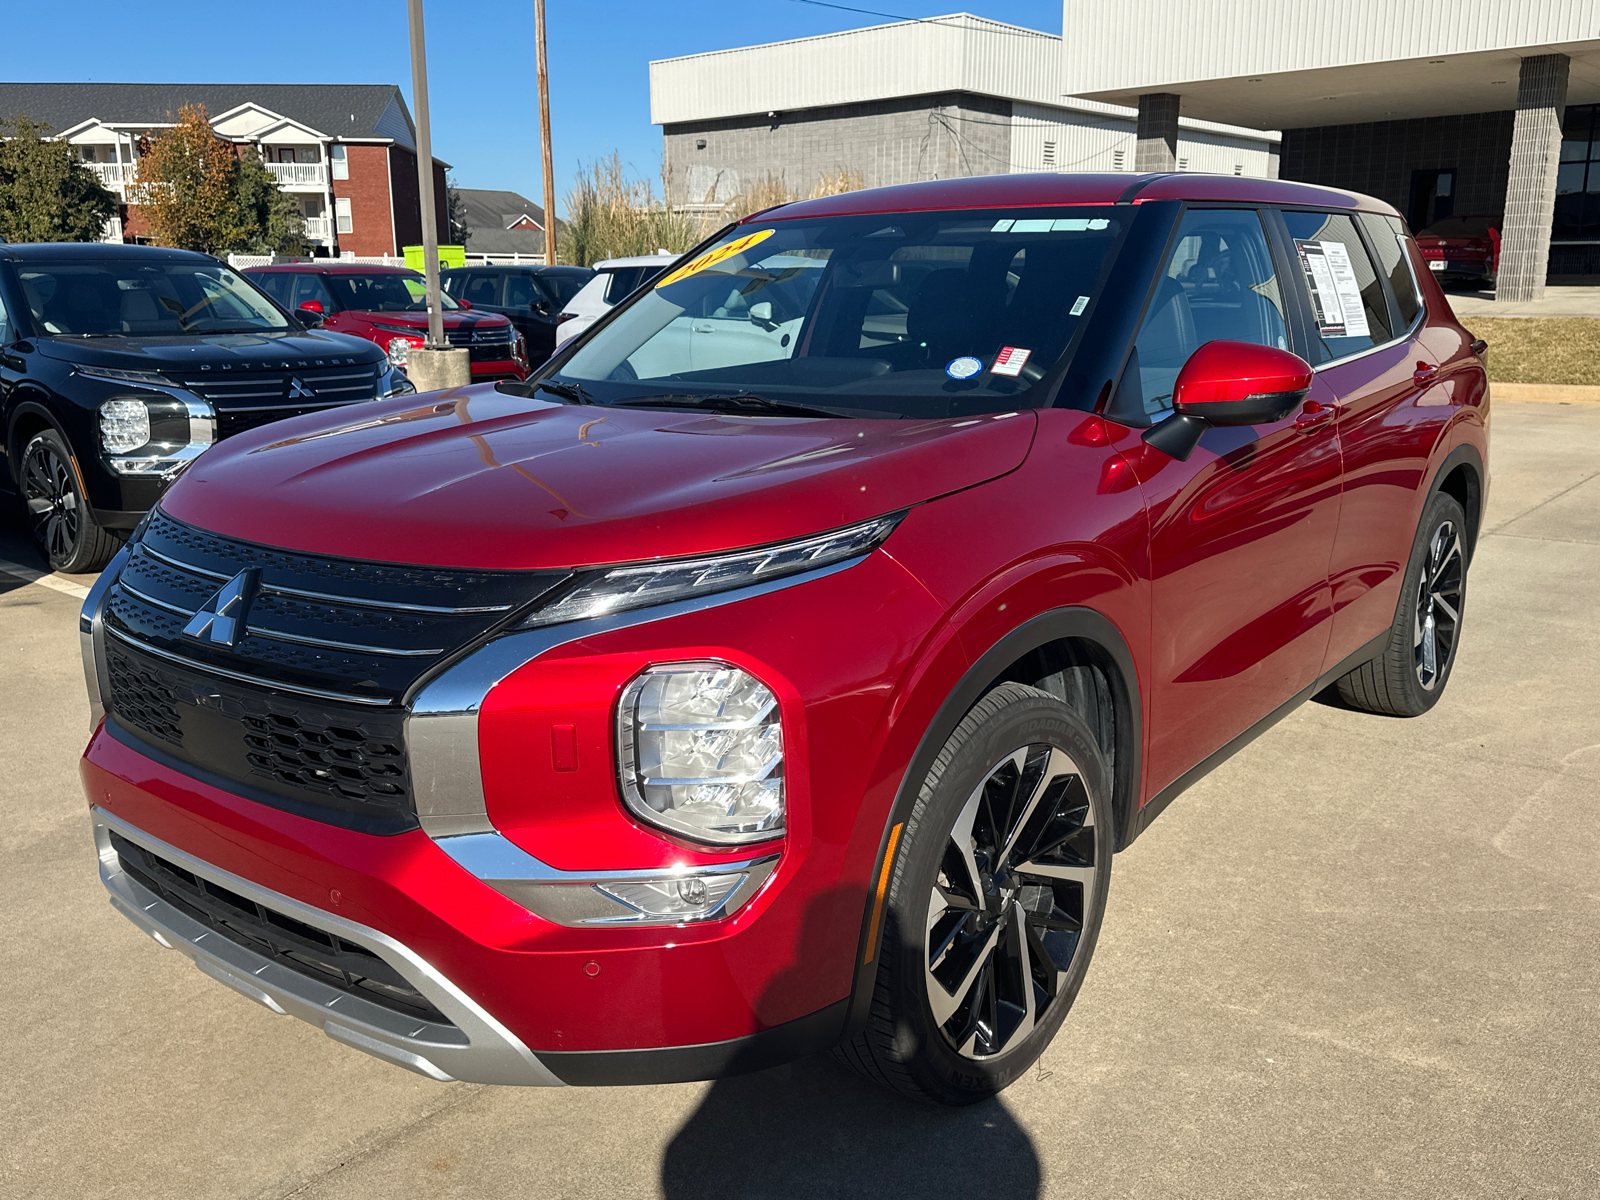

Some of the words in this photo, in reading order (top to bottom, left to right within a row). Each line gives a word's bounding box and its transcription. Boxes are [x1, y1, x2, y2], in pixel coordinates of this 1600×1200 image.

[671, 235, 757, 282] 2024
[201, 358, 356, 371] OUTLANDER
[1018, 718, 1076, 738] ROADIAN
[952, 1067, 1010, 1088] NEXEN
